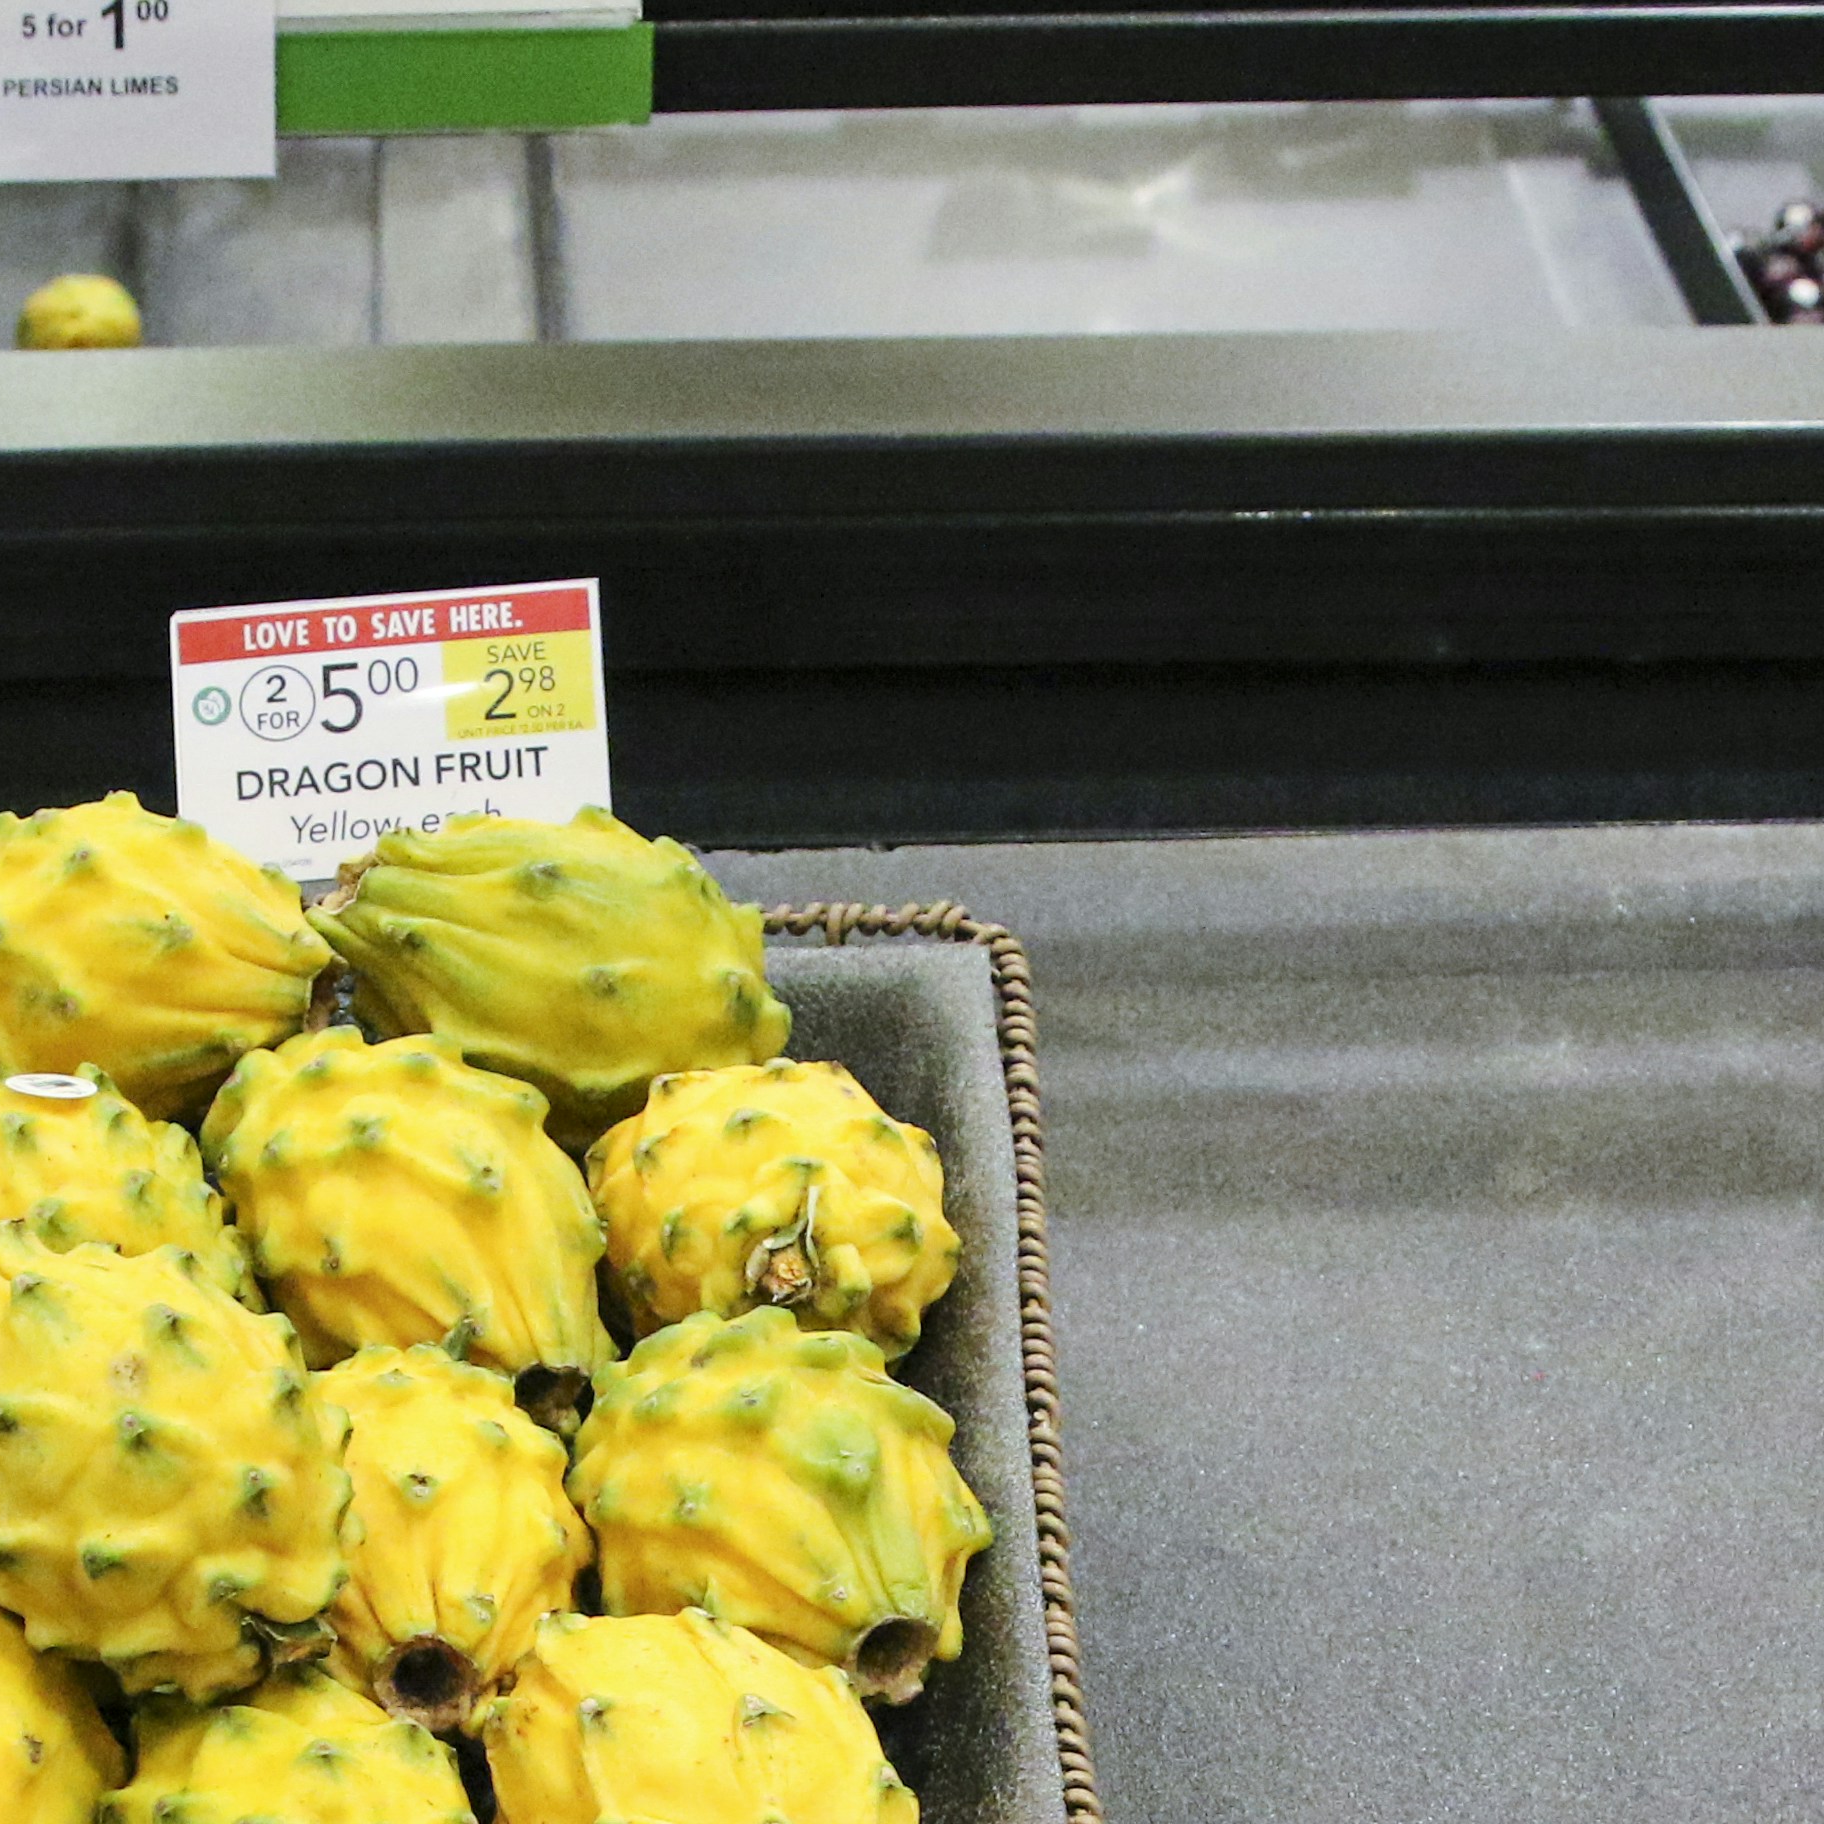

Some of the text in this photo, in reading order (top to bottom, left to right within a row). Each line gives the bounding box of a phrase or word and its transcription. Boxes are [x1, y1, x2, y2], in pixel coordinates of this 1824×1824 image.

[22, 15, 36, 38] 5
[47, 13, 87, 38] for
[2, 76, 179, 97] PERSIAN LIMES
[243, 601, 524, 651] LOVE TO SAVE HERE.
[487, 641, 547, 664] SAVE
[266, 673, 287, 704] 2
[256, 710, 301, 731] FOR
[527, 703, 566, 719] ON 2
[236, 746, 549, 801] DRAGON FRUIT
